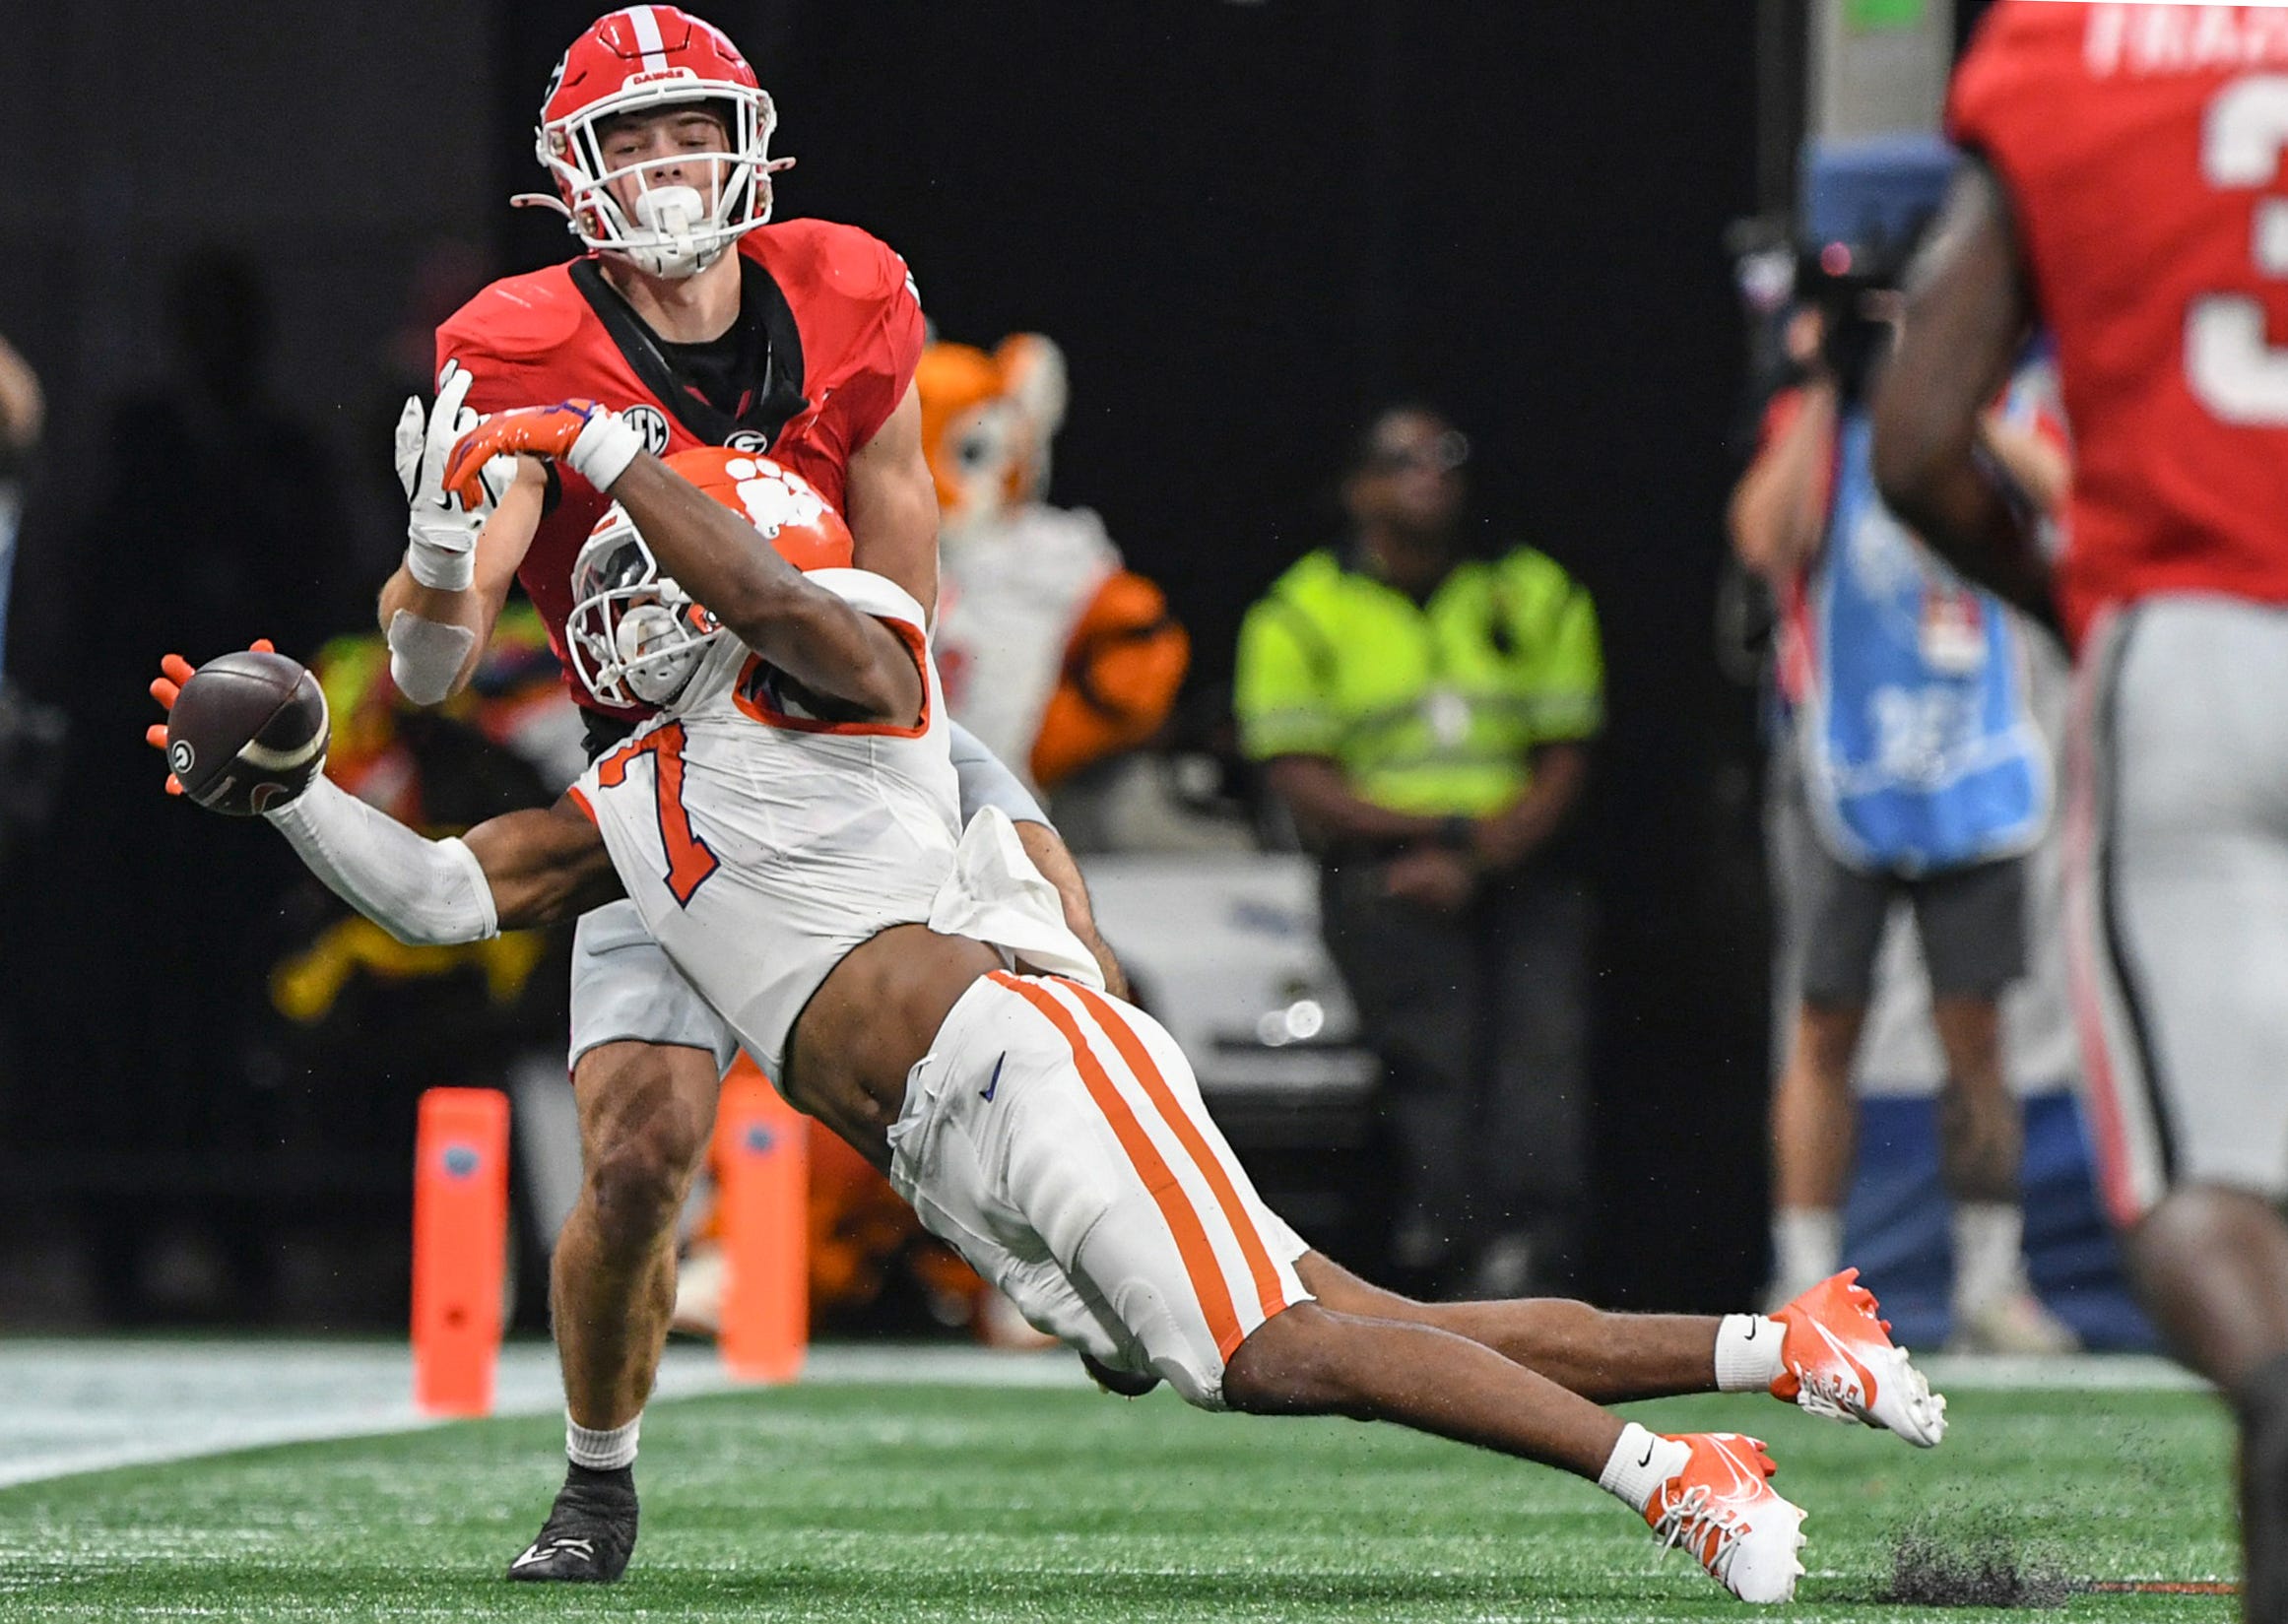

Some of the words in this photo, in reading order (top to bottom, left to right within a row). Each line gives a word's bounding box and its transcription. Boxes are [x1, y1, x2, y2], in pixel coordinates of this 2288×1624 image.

[633, 70, 685, 85] DAWGS
[623, 409, 665, 456] EC
[598, 718, 721, 911] 7
